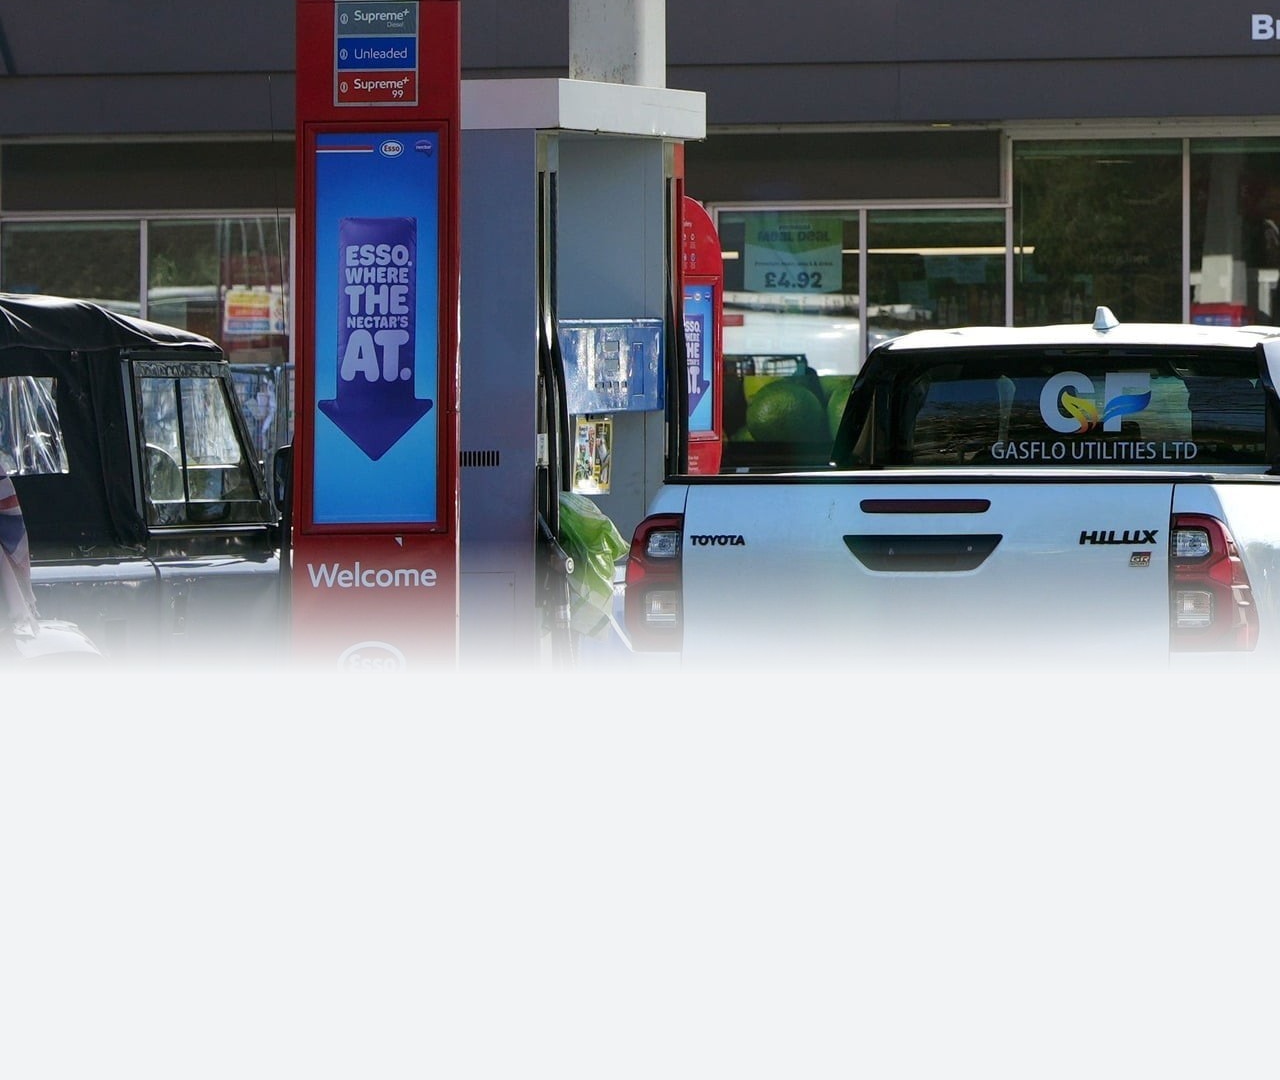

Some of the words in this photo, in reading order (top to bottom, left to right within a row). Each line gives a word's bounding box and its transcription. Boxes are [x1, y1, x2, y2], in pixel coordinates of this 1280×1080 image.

[353, 47, 408, 60] Unleaded
[391, 90, 404, 98] 99
[345, 243, 413, 267] ESSO.
[345, 266, 409, 284] WHERE
[764, 272, 822, 289] £4.92
[344, 284, 409, 316] THE
[346, 316, 409, 329] NECTAR'S
[682, 321, 701, 333] SSO.
[340, 329, 412, 383] AT.
[686, 342, 700, 359] HE
[991, 441, 1066, 460] GASFLO
[1071, 441, 1157, 460] UTILITIES
[1162, 441, 1198, 460] LTD
[690, 534, 746, 546] TOYOTA
[1079, 530, 1159, 545] HILUX
[307, 561, 438, 588] Welcome
